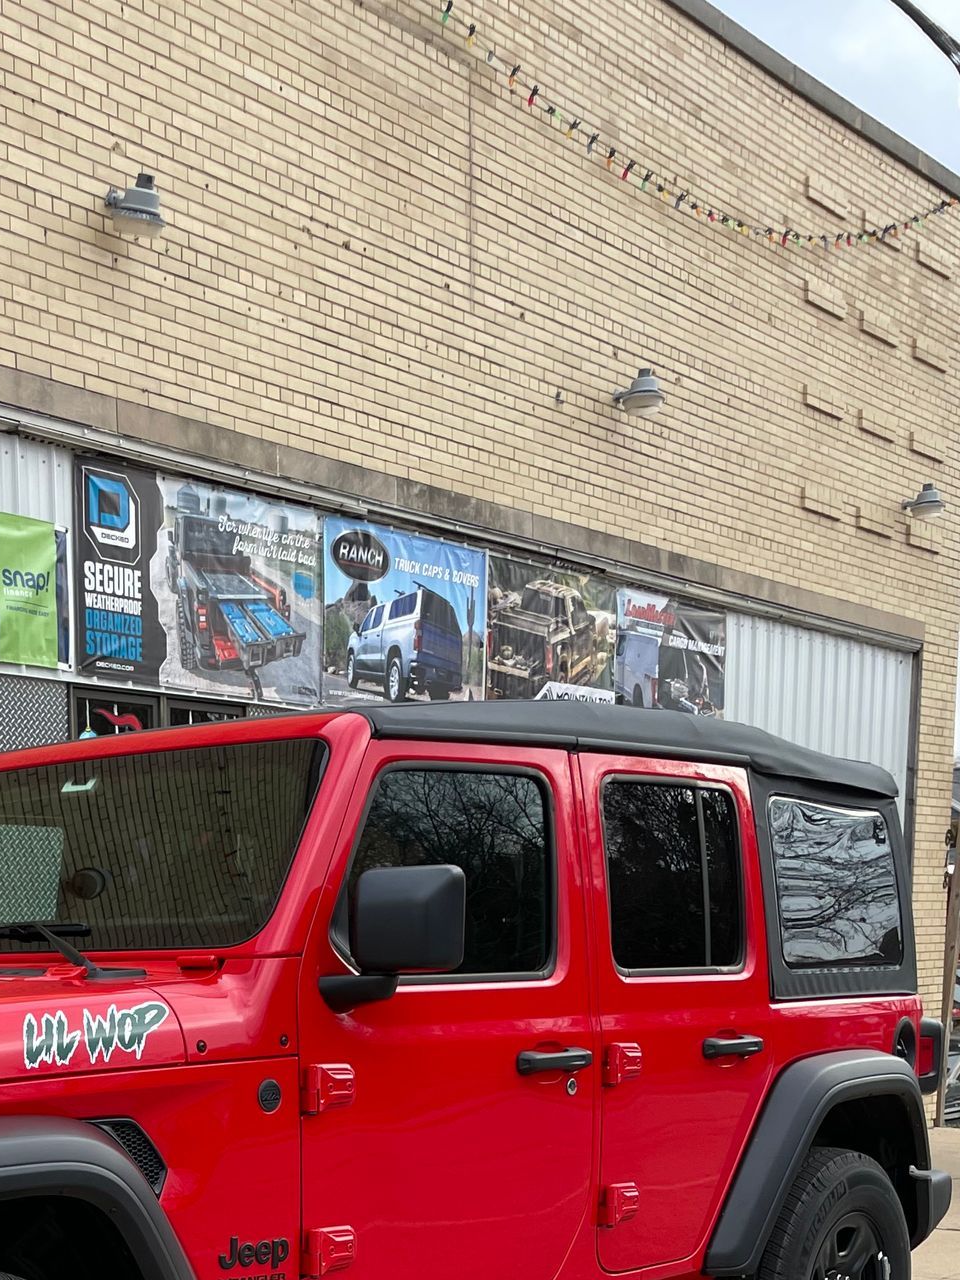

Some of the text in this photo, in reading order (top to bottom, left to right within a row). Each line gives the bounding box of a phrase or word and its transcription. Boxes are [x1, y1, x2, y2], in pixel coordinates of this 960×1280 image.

[101, 533, 130, 543] DECKED
[218, 515, 311, 549] For when life on the
[232, 536, 258, 555] farm
[278, 546, 296, 563] laid
[339, 542, 384, 569] RANCH
[2, 568, 50, 596] snap!
[84, 560, 142, 600] SECURE
[394, 557, 480, 588] TRUCK CAPS & COVERS
[85, 591, 143, 616] WEATHERPROOF
[86, 608, 143, 637] ORGANIZED
[86, 630, 143, 663] STORAGE
[668, 636, 688, 649] CARGO
[23, 1001, 169, 1069] LIL WOP
[218, 1235, 289, 1270] Jeep
